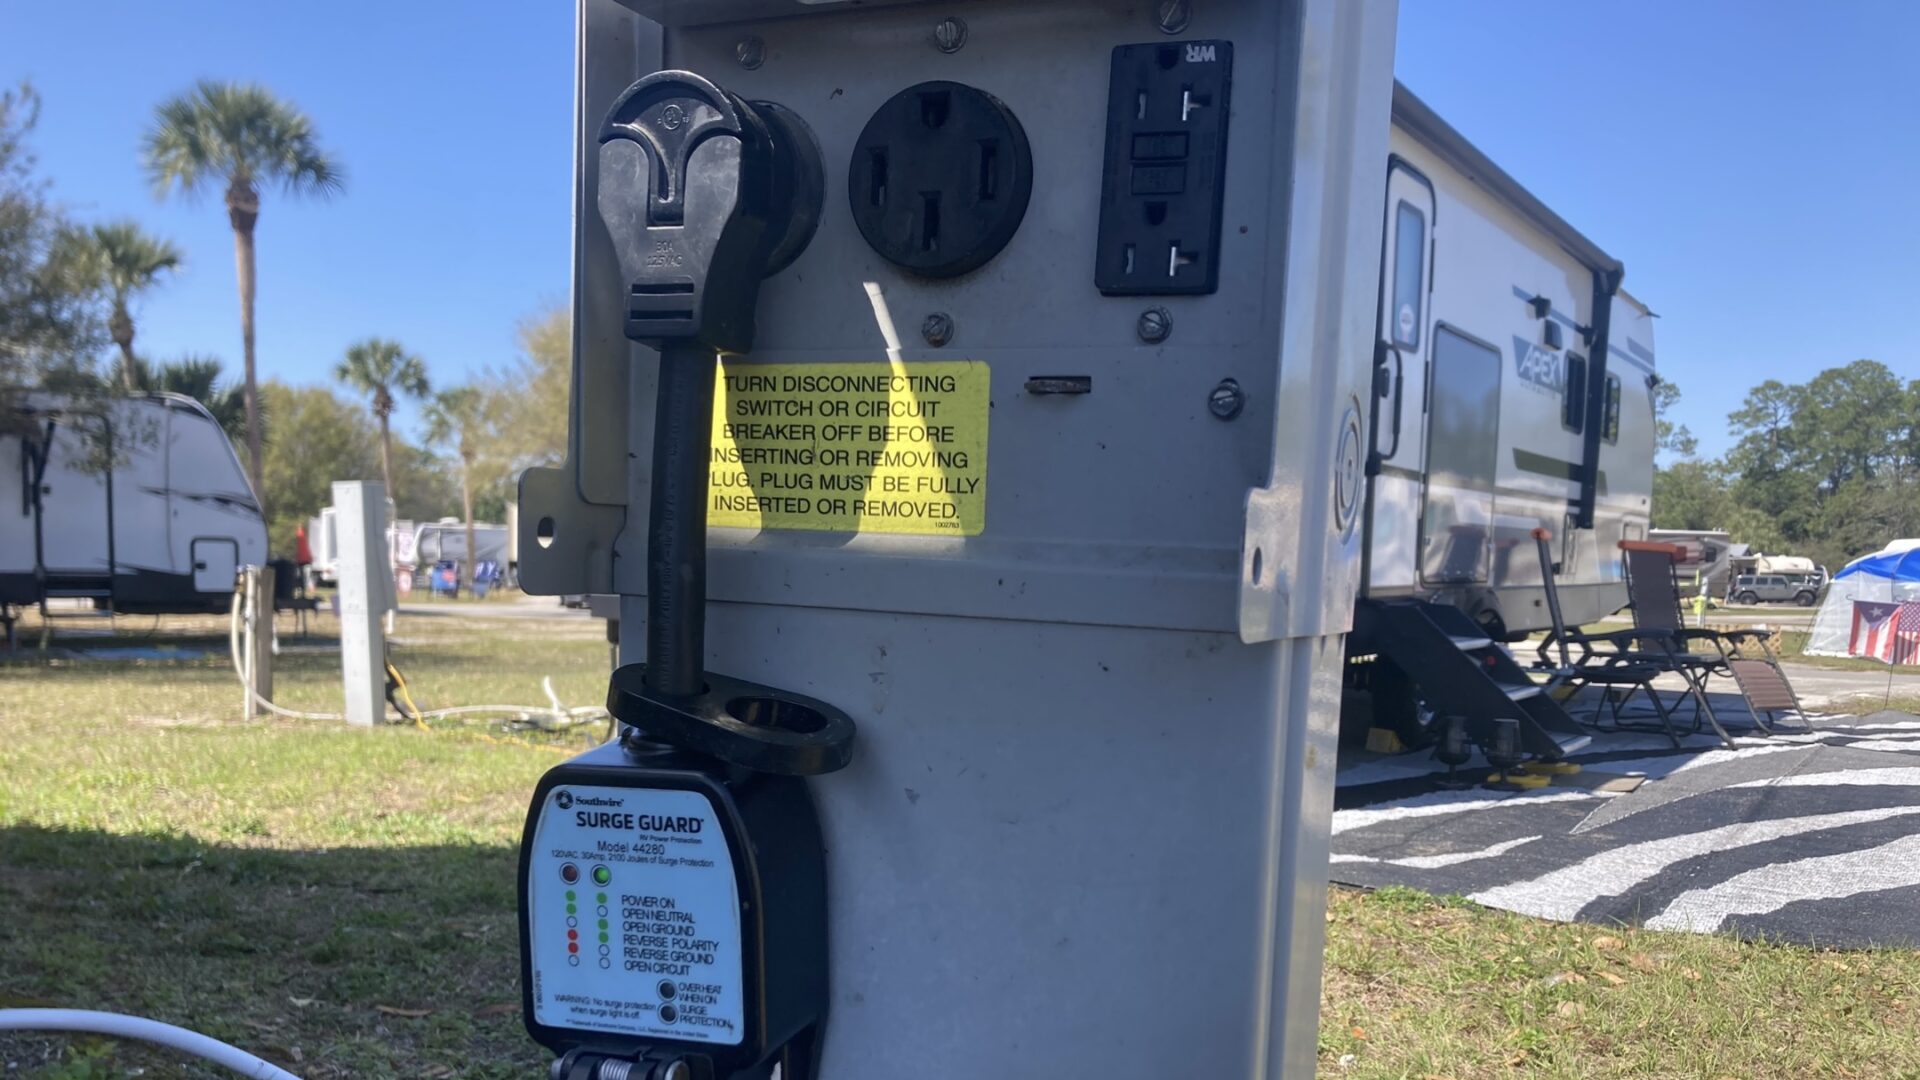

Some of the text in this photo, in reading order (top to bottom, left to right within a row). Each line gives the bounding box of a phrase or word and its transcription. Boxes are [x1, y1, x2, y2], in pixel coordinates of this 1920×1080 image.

[1186, 43, 1216, 62] WR
[1519, 343, 1558, 387] APEX
[724, 376, 955, 392] TURN DISCONNECTING
[737, 401, 940, 418] SWITCH OR CIRCUIT
[723, 424, 954, 442] BREAKER OFF BEFORE
[820, 450, 848, 466] OR
[857, 451, 968, 469] REMOVING
[710, 472, 979, 494] LUG. PLUG MUST BE FULLY
[714, 496, 960, 519] INSERTED OR REMOVED.
[576, 810, 702, 834] SURGE GUARD
[597, 840, 666, 855] Model 44280
[650, 856, 657, 864] of
[658, 856, 678, 867] Surge
[679, 858, 714, 868] Protection
[622, 894, 675, 908] POWER ON
[622, 908, 696, 924] OPEN NEUTRAL
[622, 920, 695, 936] OPEN GROUND
[624, 934, 720, 951] REVERSE POLARITY
[624, 947, 714, 965] REVERSE GROUND
[624, 960, 691, 976] OPEN CIRCUIT
[680, 1004, 708, 1016] SURGE
